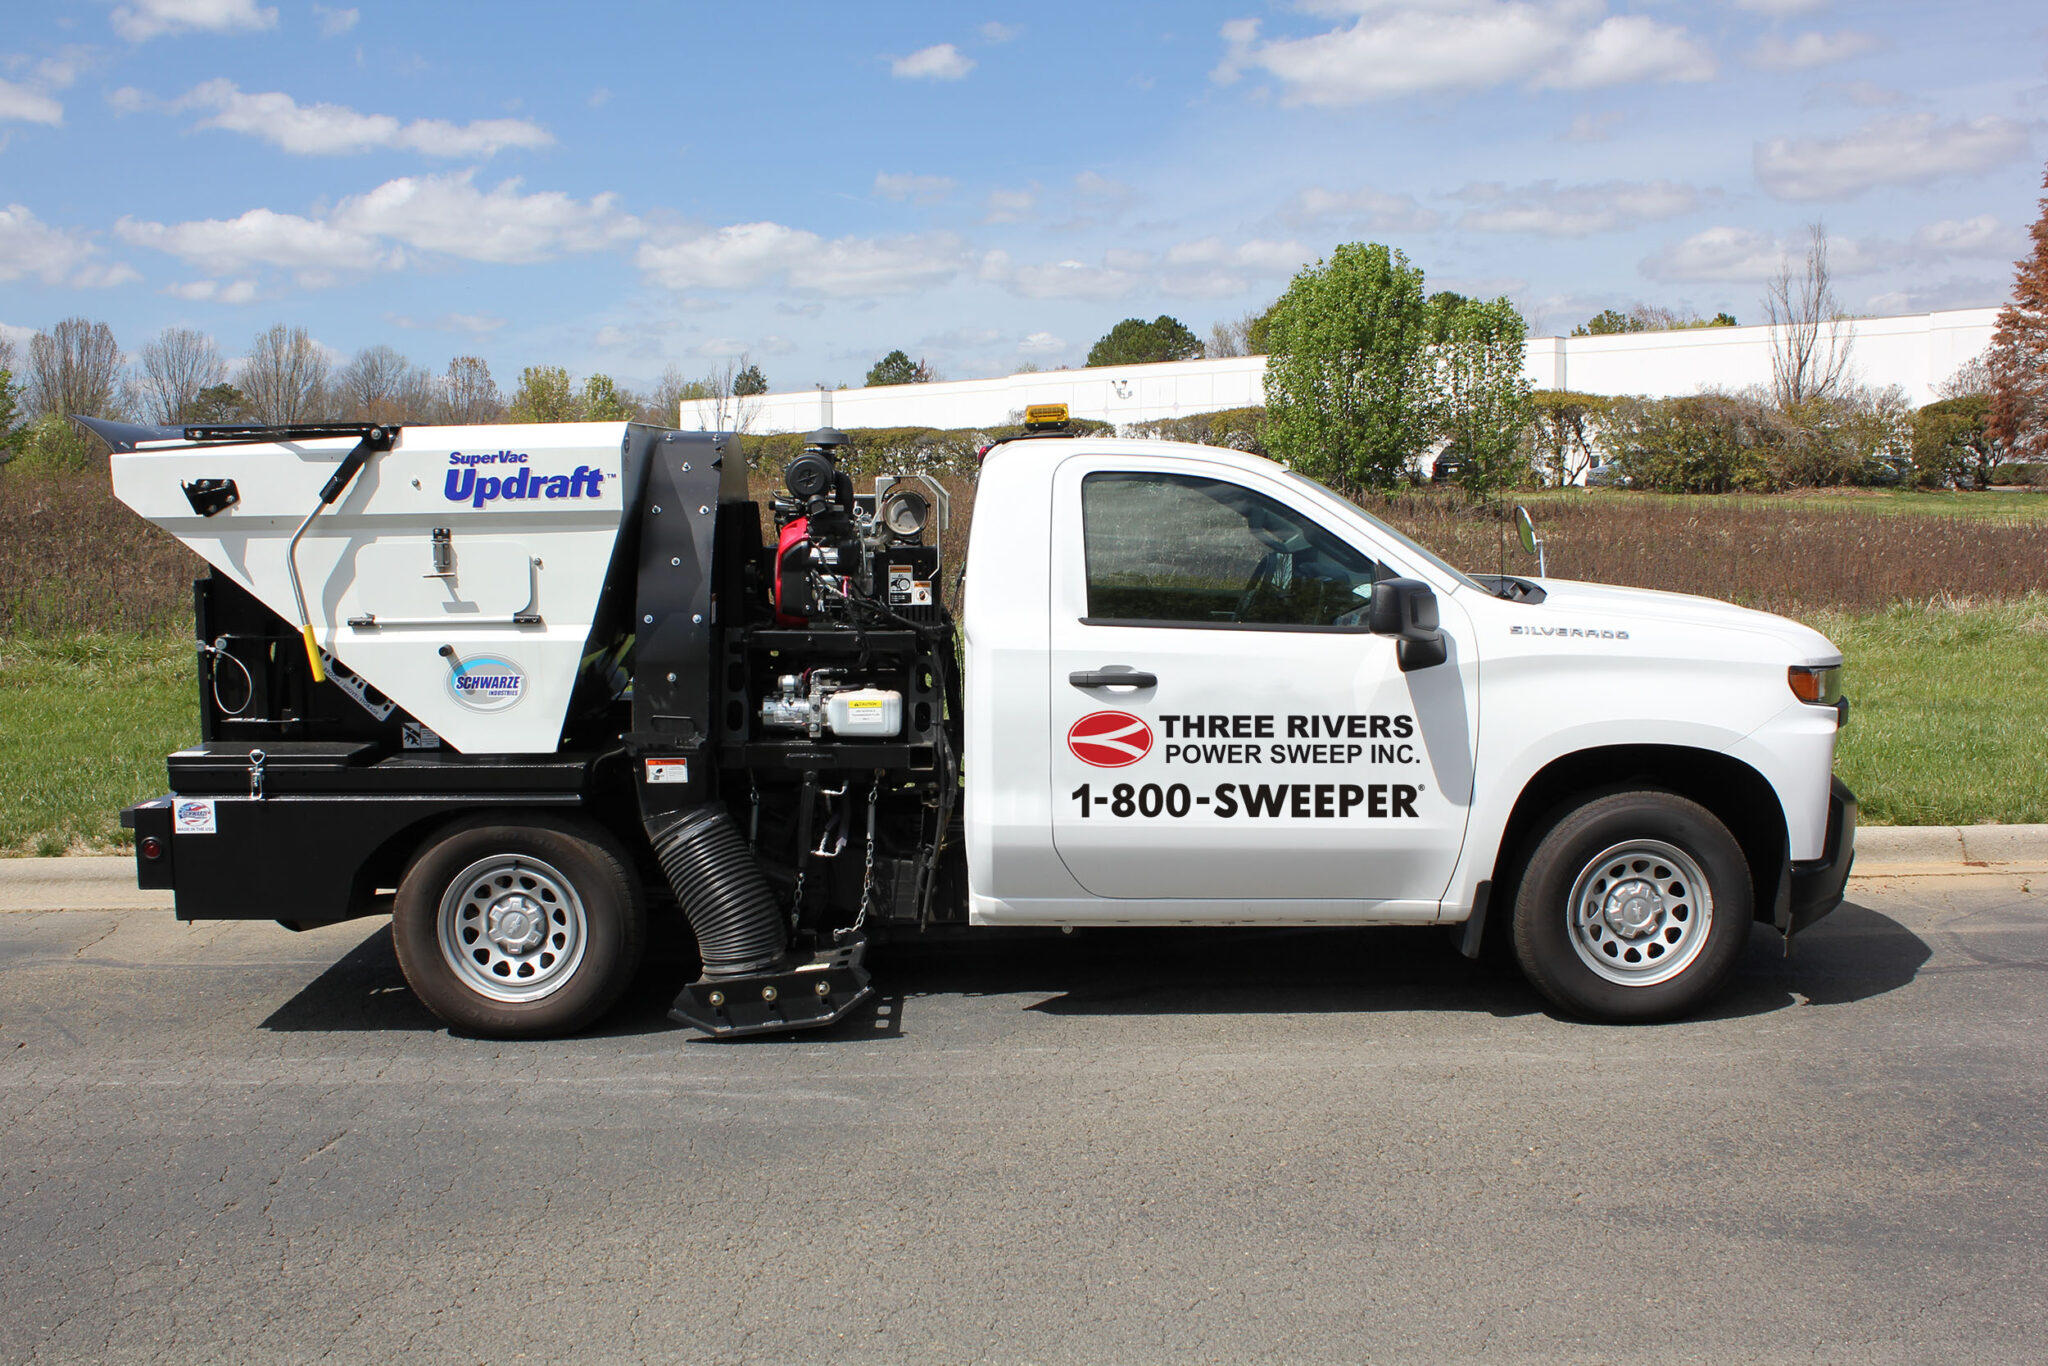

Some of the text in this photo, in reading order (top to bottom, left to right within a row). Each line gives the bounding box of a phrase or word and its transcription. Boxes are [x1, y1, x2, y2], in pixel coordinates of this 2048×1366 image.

[449, 450, 529, 467] SuperVac
[444, 465, 605, 509] Updraft
[1509, 625, 1630, 640] SILVERADO
[456, 676, 520, 689] SCHWARZE
[1159, 715, 1414, 738] THREE RIVERS
[1165, 744, 1421, 764] POWER SWEEP INC.
